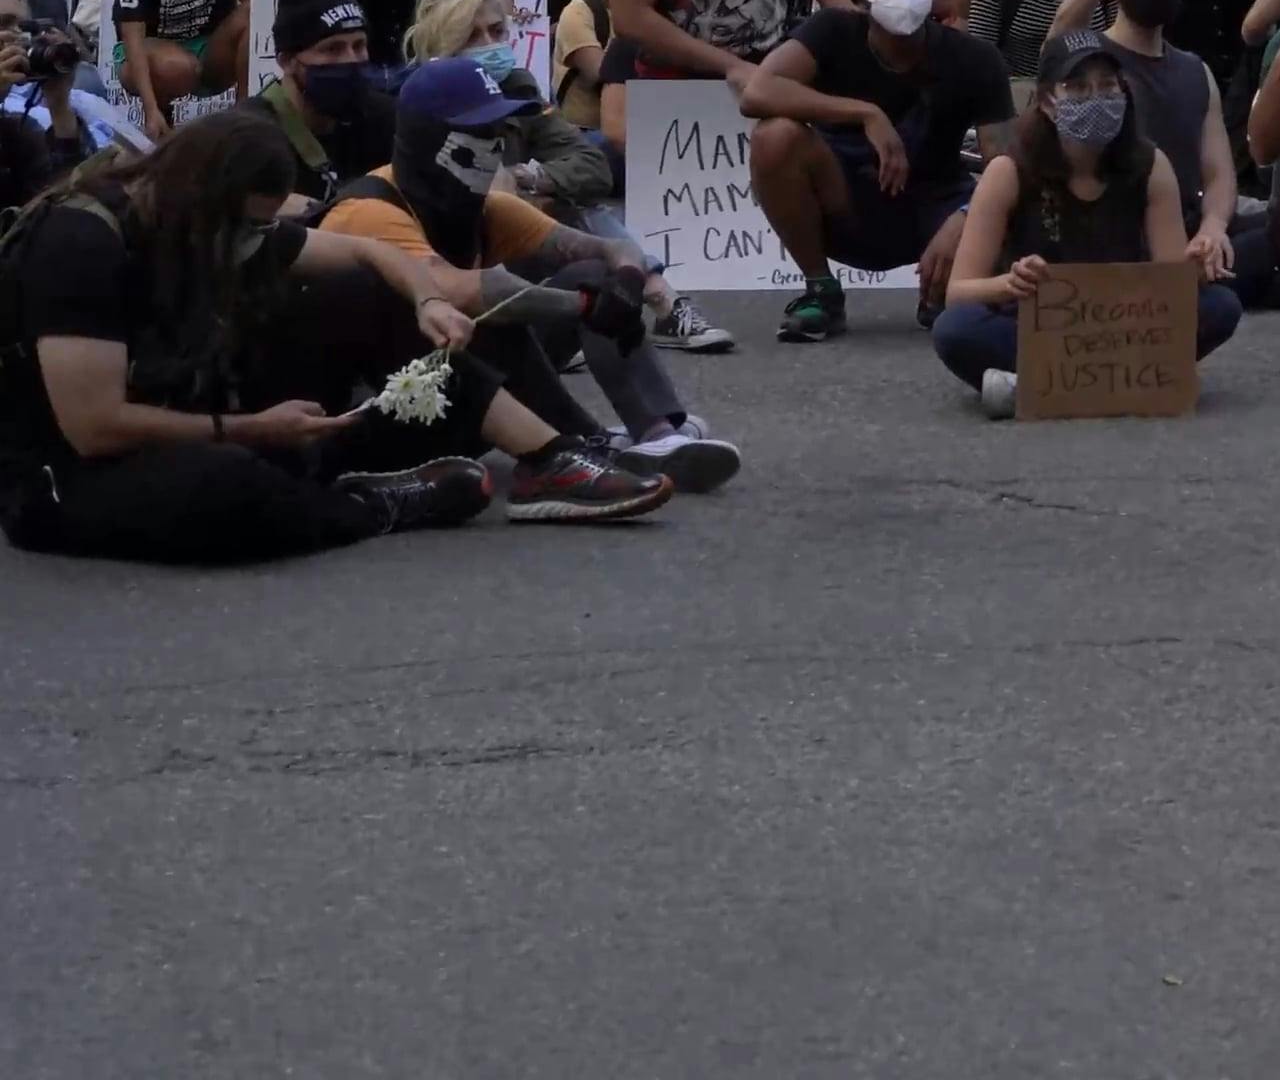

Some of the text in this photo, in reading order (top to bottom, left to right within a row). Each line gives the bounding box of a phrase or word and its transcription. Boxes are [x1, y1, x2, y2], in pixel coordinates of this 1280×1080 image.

[662, 182, 760, 217] MAM
[645, 228, 684, 268] I
[1036, 360, 1177, 398] JUSTICE
